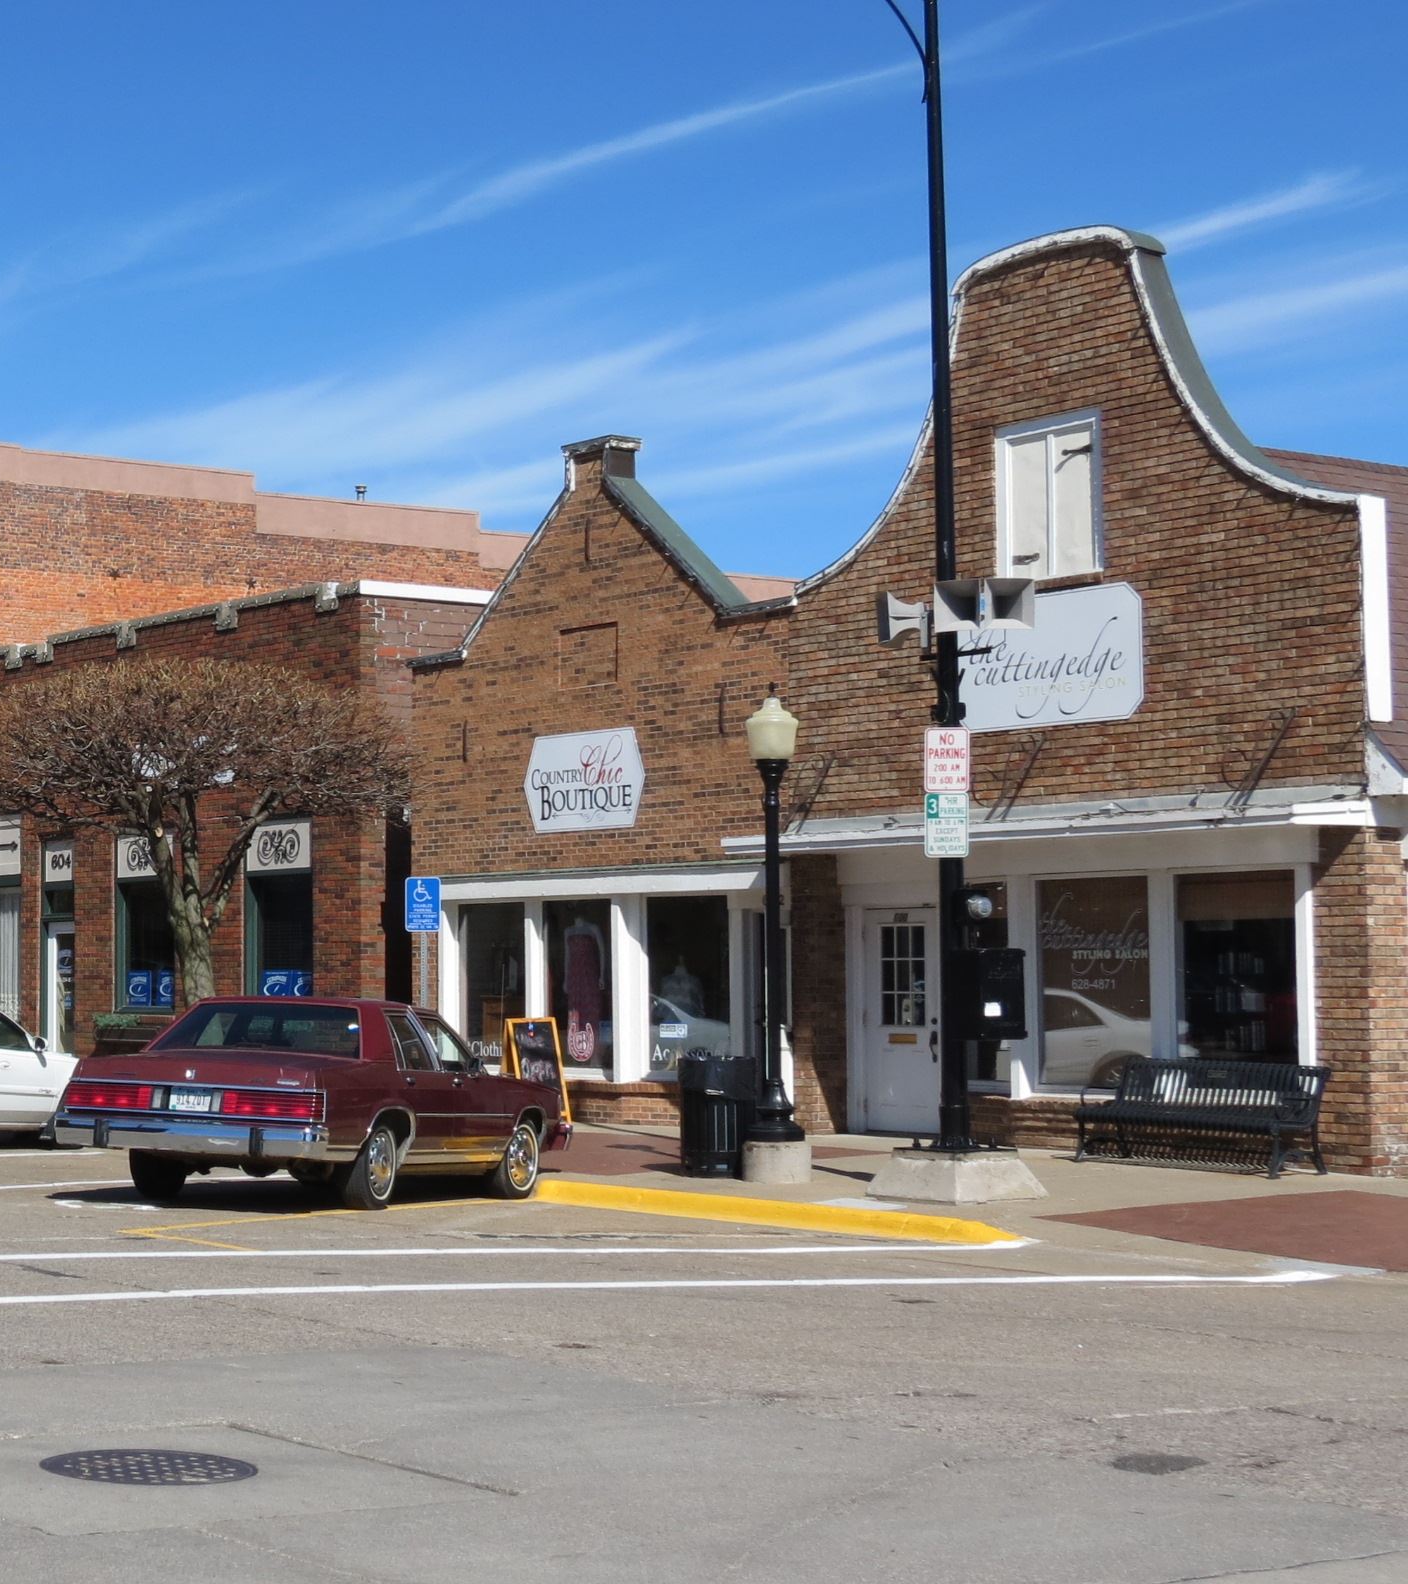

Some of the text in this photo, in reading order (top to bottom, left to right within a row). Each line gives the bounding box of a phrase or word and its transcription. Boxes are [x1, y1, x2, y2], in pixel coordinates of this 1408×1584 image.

[1018, 676, 1128, 698] STYLING SALON
[939, 733, 955, 746] NO
[580, 734, 624, 786] Chic
[928, 748, 966, 759] PARKING
[951, 763, 961, 772] AM
[928, 776, 937, 785] TO
[956, 776, 966, 785] AM
[928, 798, 938, 814] 3
[51, 853, 72, 870] 604
[1072, 949, 1148, 960] STYLING SALON
[1072, 978, 1116, 990] 628-4871
[471, 1040, 503, 1058] Clothi
